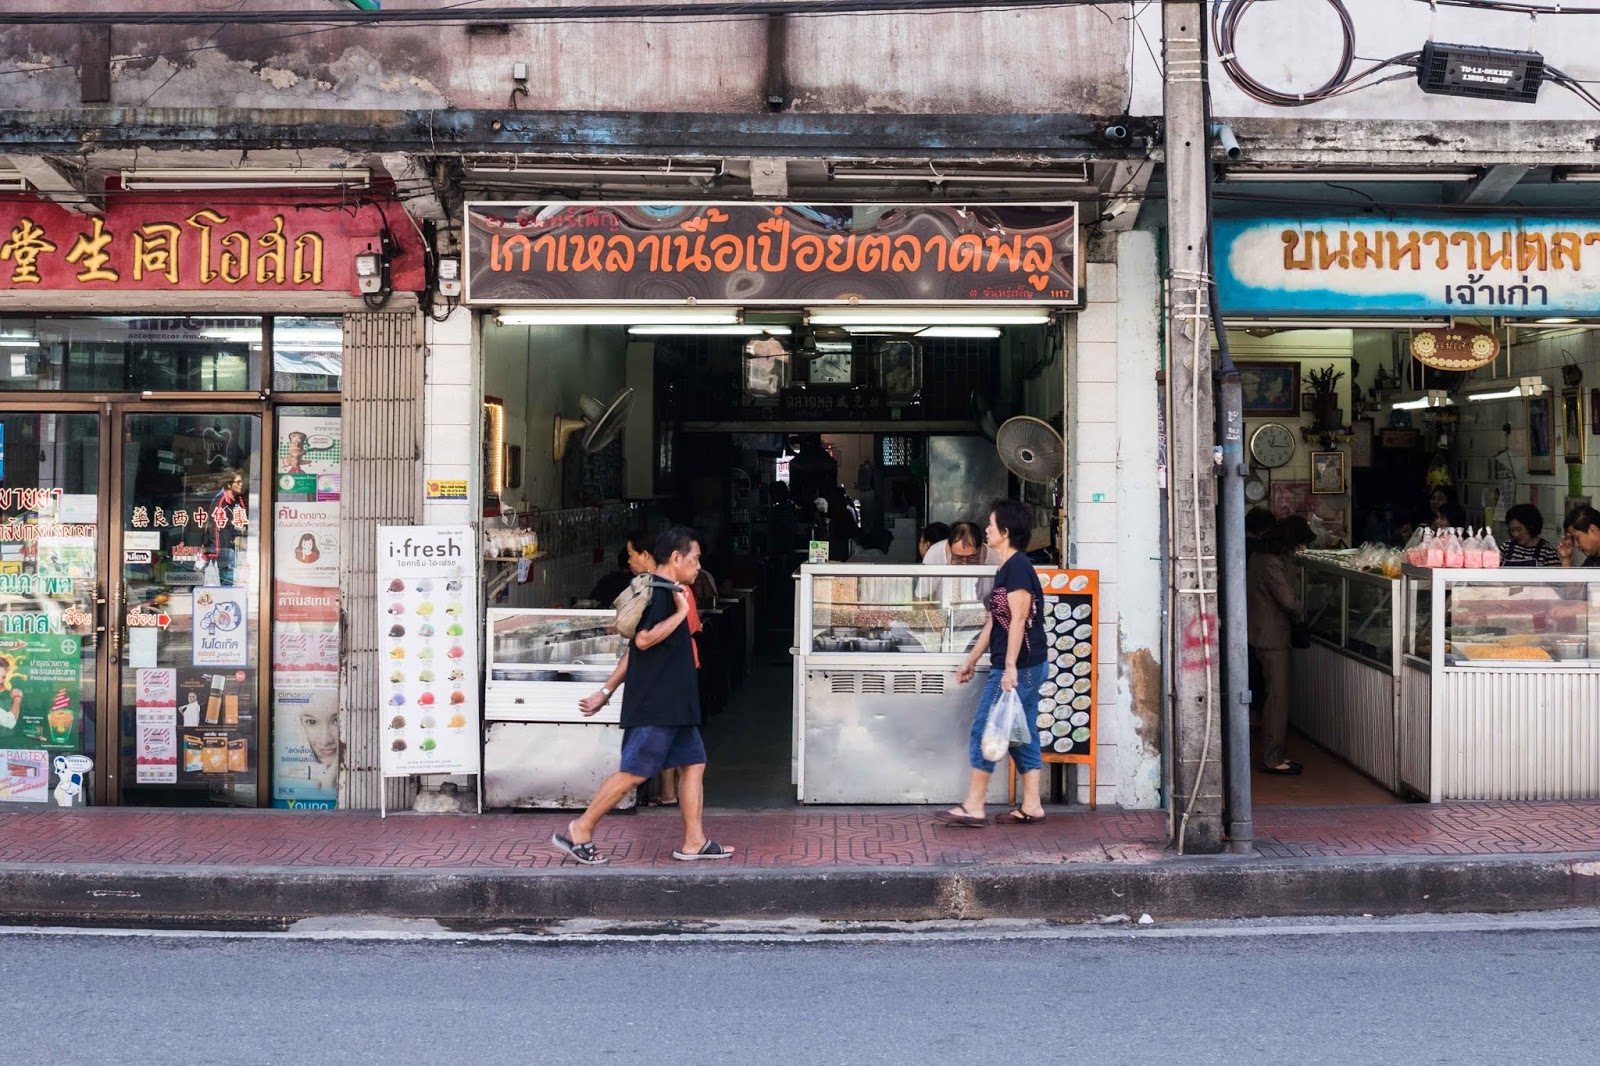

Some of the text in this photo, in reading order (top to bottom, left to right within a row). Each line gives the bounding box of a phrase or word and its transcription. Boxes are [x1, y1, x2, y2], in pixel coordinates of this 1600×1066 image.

[186, 208, 324, 285] โอสถ
[1050, 289, 1070, 298] 1117
[1445, 274, 1548, 305] เจ้าเก่า
[278, 505, 298, 519] คัน
[127, 605, 156, 626] เลื่อน
[7, 751, 47, 761] BACTEX
